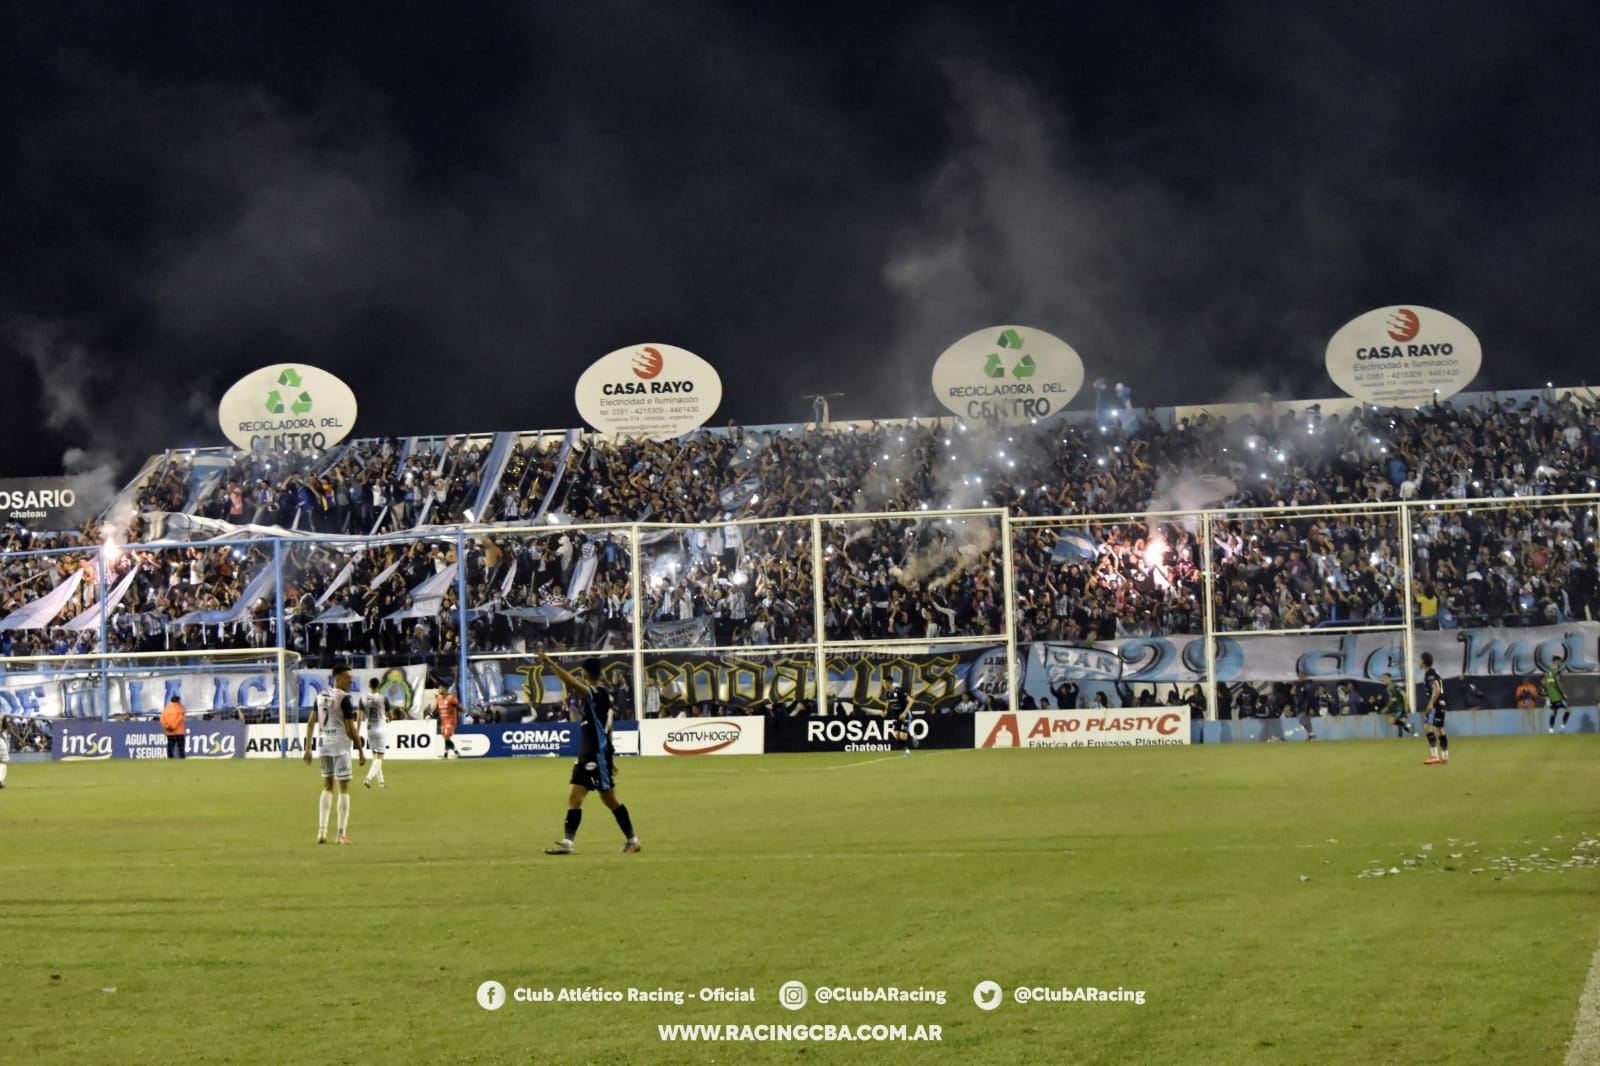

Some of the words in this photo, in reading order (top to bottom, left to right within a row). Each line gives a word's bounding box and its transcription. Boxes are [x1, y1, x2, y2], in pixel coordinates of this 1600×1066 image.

[1356, 345, 1403, 360] CASA
[1407, 343, 1453, 357] RAYO
[603, 382, 647, 395] CASA
[651, 380, 694, 394] RAYO
[950, 383, 1034, 397] RECICLADORA
[1042, 382, 1067, 393] DEL
[600, 398, 645, 406] Electricidad
[967, 397, 1050, 420] CENTRO
[239, 419, 316, 432] RECICLADORA
[321, 417, 343, 428] DEL
[10, 510, 47, 519] chateau
[1457, 629, 1600, 675] ma
[808, 719, 929, 741] ROSARO
[1028, 717, 1080, 738] ARO
[1086, 713, 1181, 735] PLASTYC
[61, 729, 113, 755] insa
[125, 733, 147, 746] AGUA
[185, 728, 236, 754] insa
[397, 734, 431, 749] RIO
[502, 730, 571, 743] CORMAC
[1071, 739, 1085, 748] de
[128, 747, 136, 759] Y
[511, 743, 560, 751] MATERIALES
[844, 742, 891, 752] chateau
